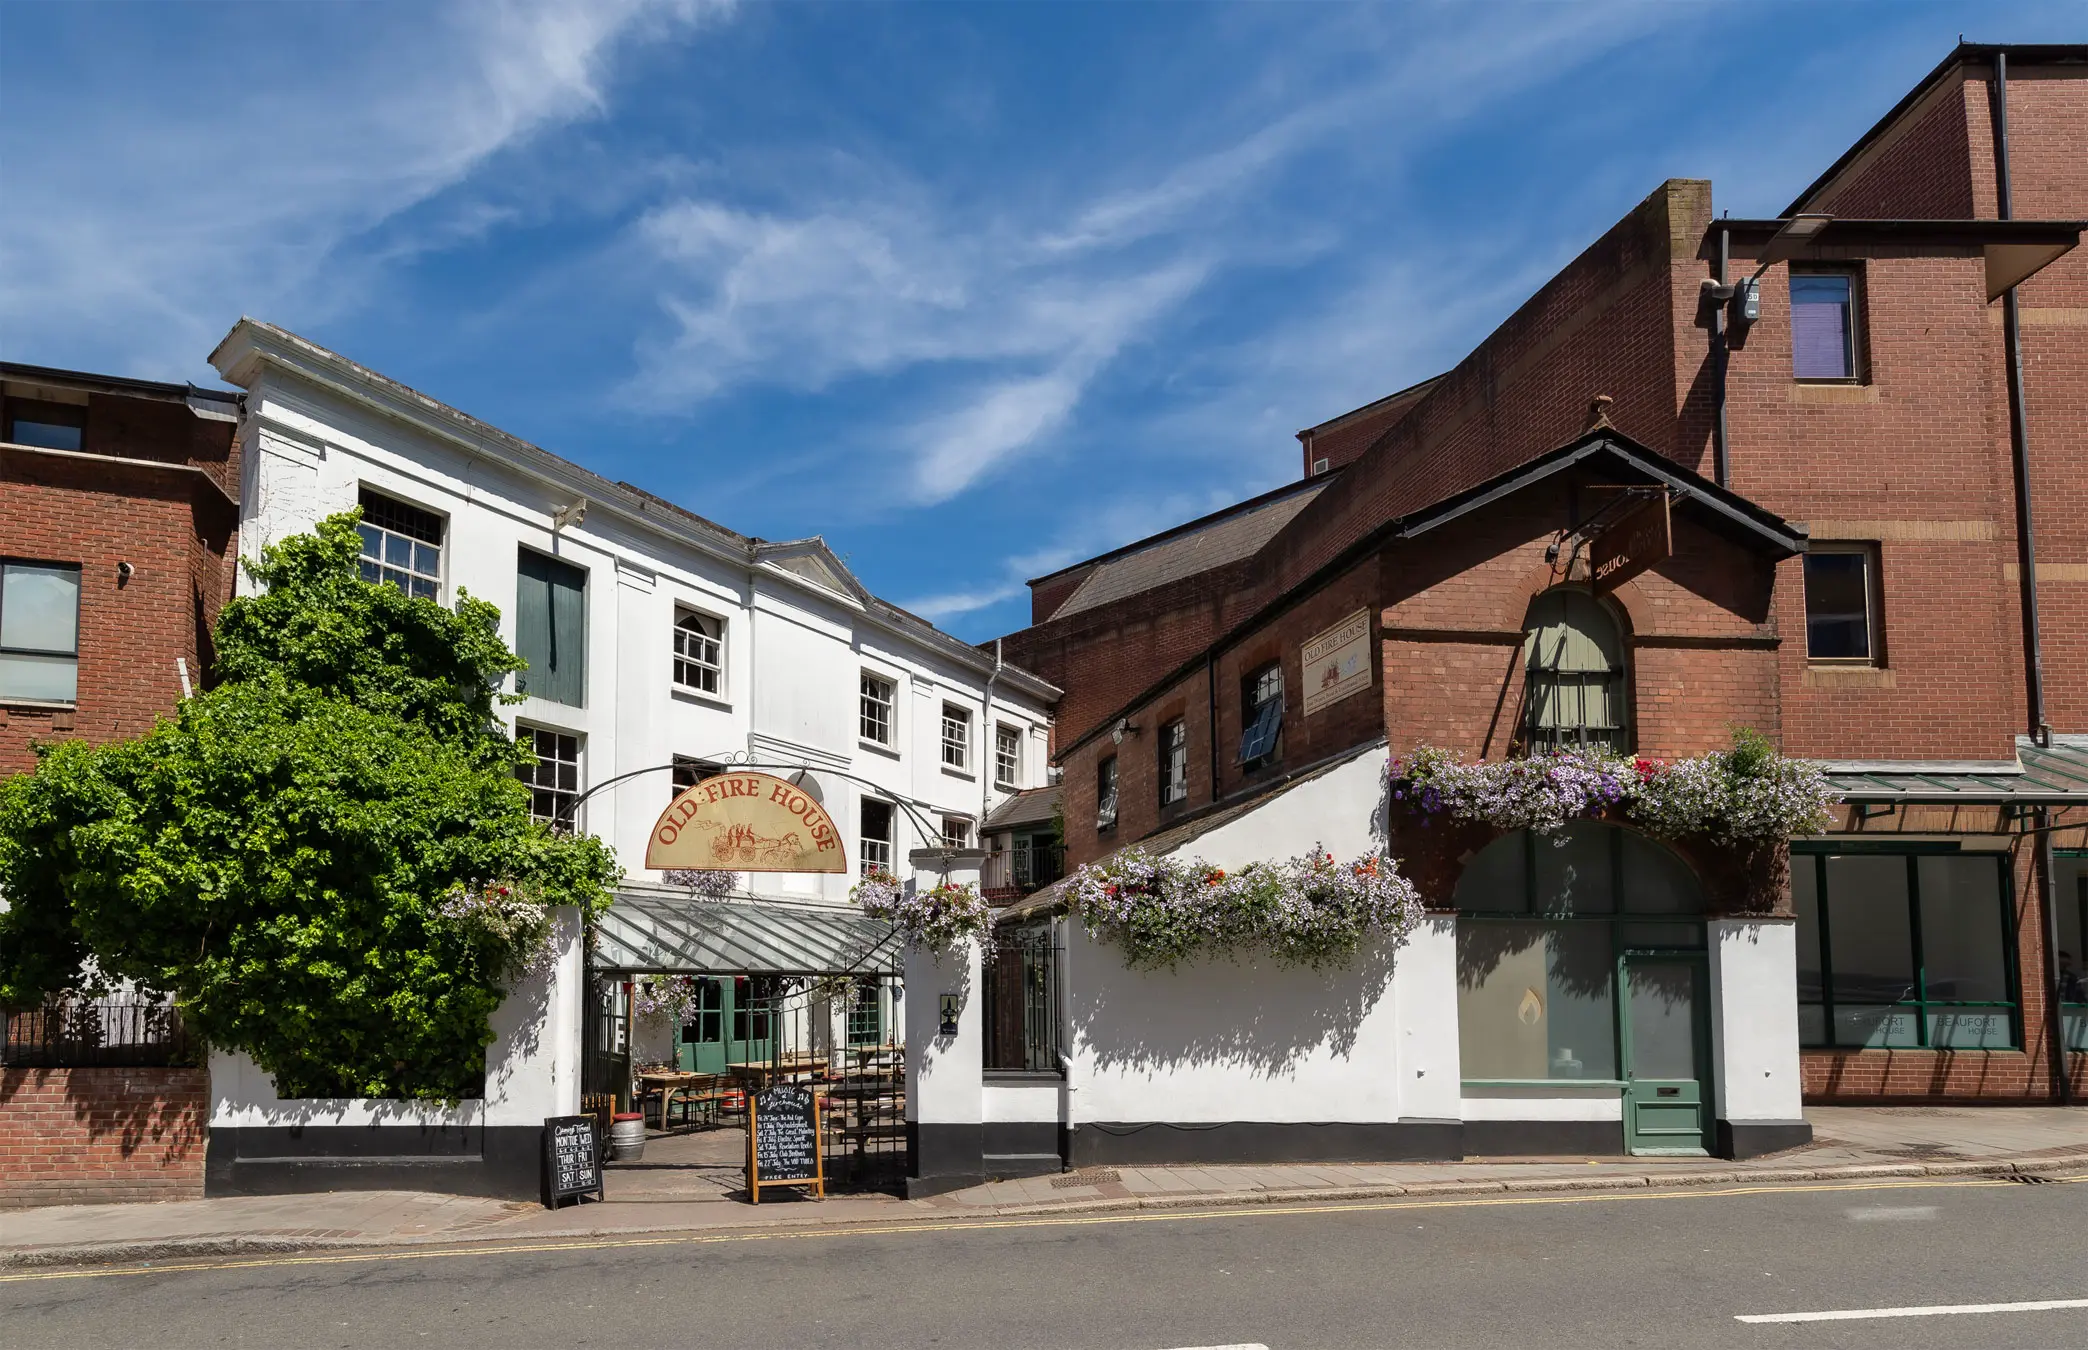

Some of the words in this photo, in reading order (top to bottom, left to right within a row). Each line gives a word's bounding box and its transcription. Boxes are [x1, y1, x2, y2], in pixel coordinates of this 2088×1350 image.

[1304, 646, 1320, 662] OLD
[1321, 636, 1339, 653] FIRE
[1340, 620, 1367, 642] HOUSE
[658, 799, 698, 846] OLD
[705, 778, 760, 804] FIRE
[769, 784, 836, 852] HOUSE
[1936, 1017, 1997, 1027] BEAUFORT
[1875, 1027, 1905, 1035] HOUSE
[1968, 1027, 1998, 1036] HOUSE
[773, 1087, 796, 1095] MUSIC
[556, 1135, 568, 1147] MON
[568, 1135, 579, 1146] TUE
[580, 1133, 591, 1144] WED
[559, 1154, 575, 1165] THUR
[578, 1151, 587, 1162] FRI
[561, 1171, 575, 1183] SAT
[579, 1169, 592, 1180] SUN
